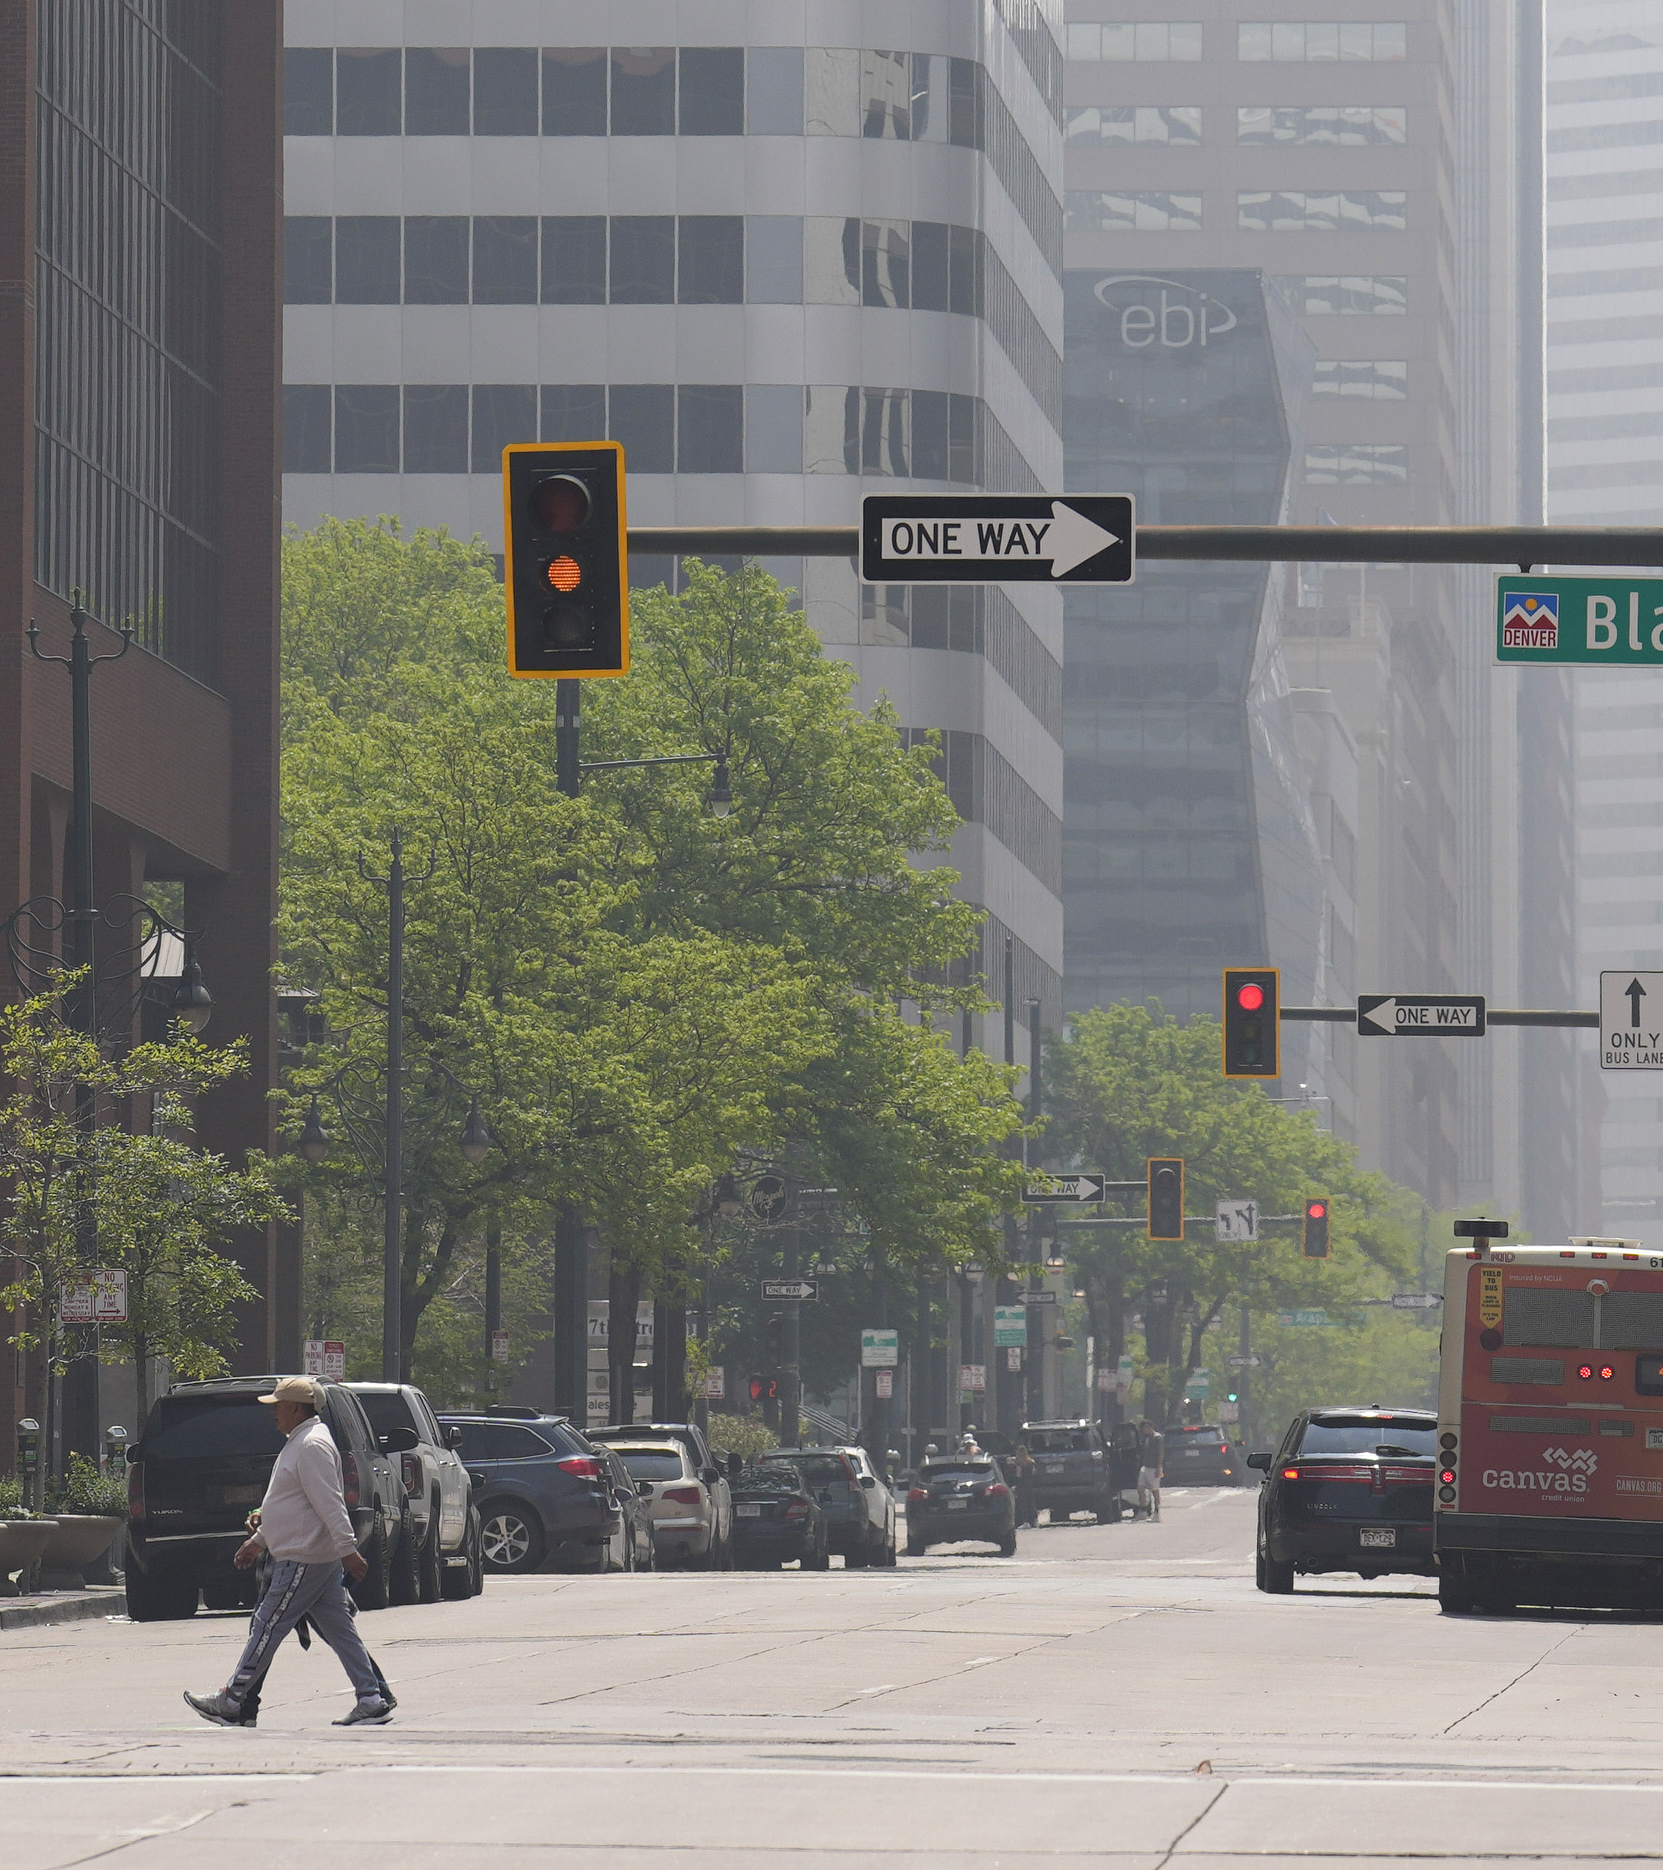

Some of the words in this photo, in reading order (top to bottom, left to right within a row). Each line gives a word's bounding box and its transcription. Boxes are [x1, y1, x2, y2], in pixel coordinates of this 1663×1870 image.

[1121, 289, 1207, 348] ebi
[892, 523, 962, 554] ONE
[977, 523, 1051, 555] WAY
[1503, 630, 1557, 648] DENVER
[1395, 1008, 1431, 1024] ONE
[1437, 1008, 1472, 1024] WAY
[1610, 1032, 1661, 1049] ONLY
[1605, 1052, 1630, 1064] BUS
[1057, 1184, 1079, 1194] WAY
[105, 1273, 115, 1282] NO
[767, 1286, 783, 1295] ONE
[785, 1286, 801, 1295] WAY
[1482, 1469, 1588, 1493] canvas
[1617, 1480, 1662, 1492] CANVAS.ORG
[1541, 1493, 1562, 1502] credit
[1565, 1494, 1585, 1502] union
